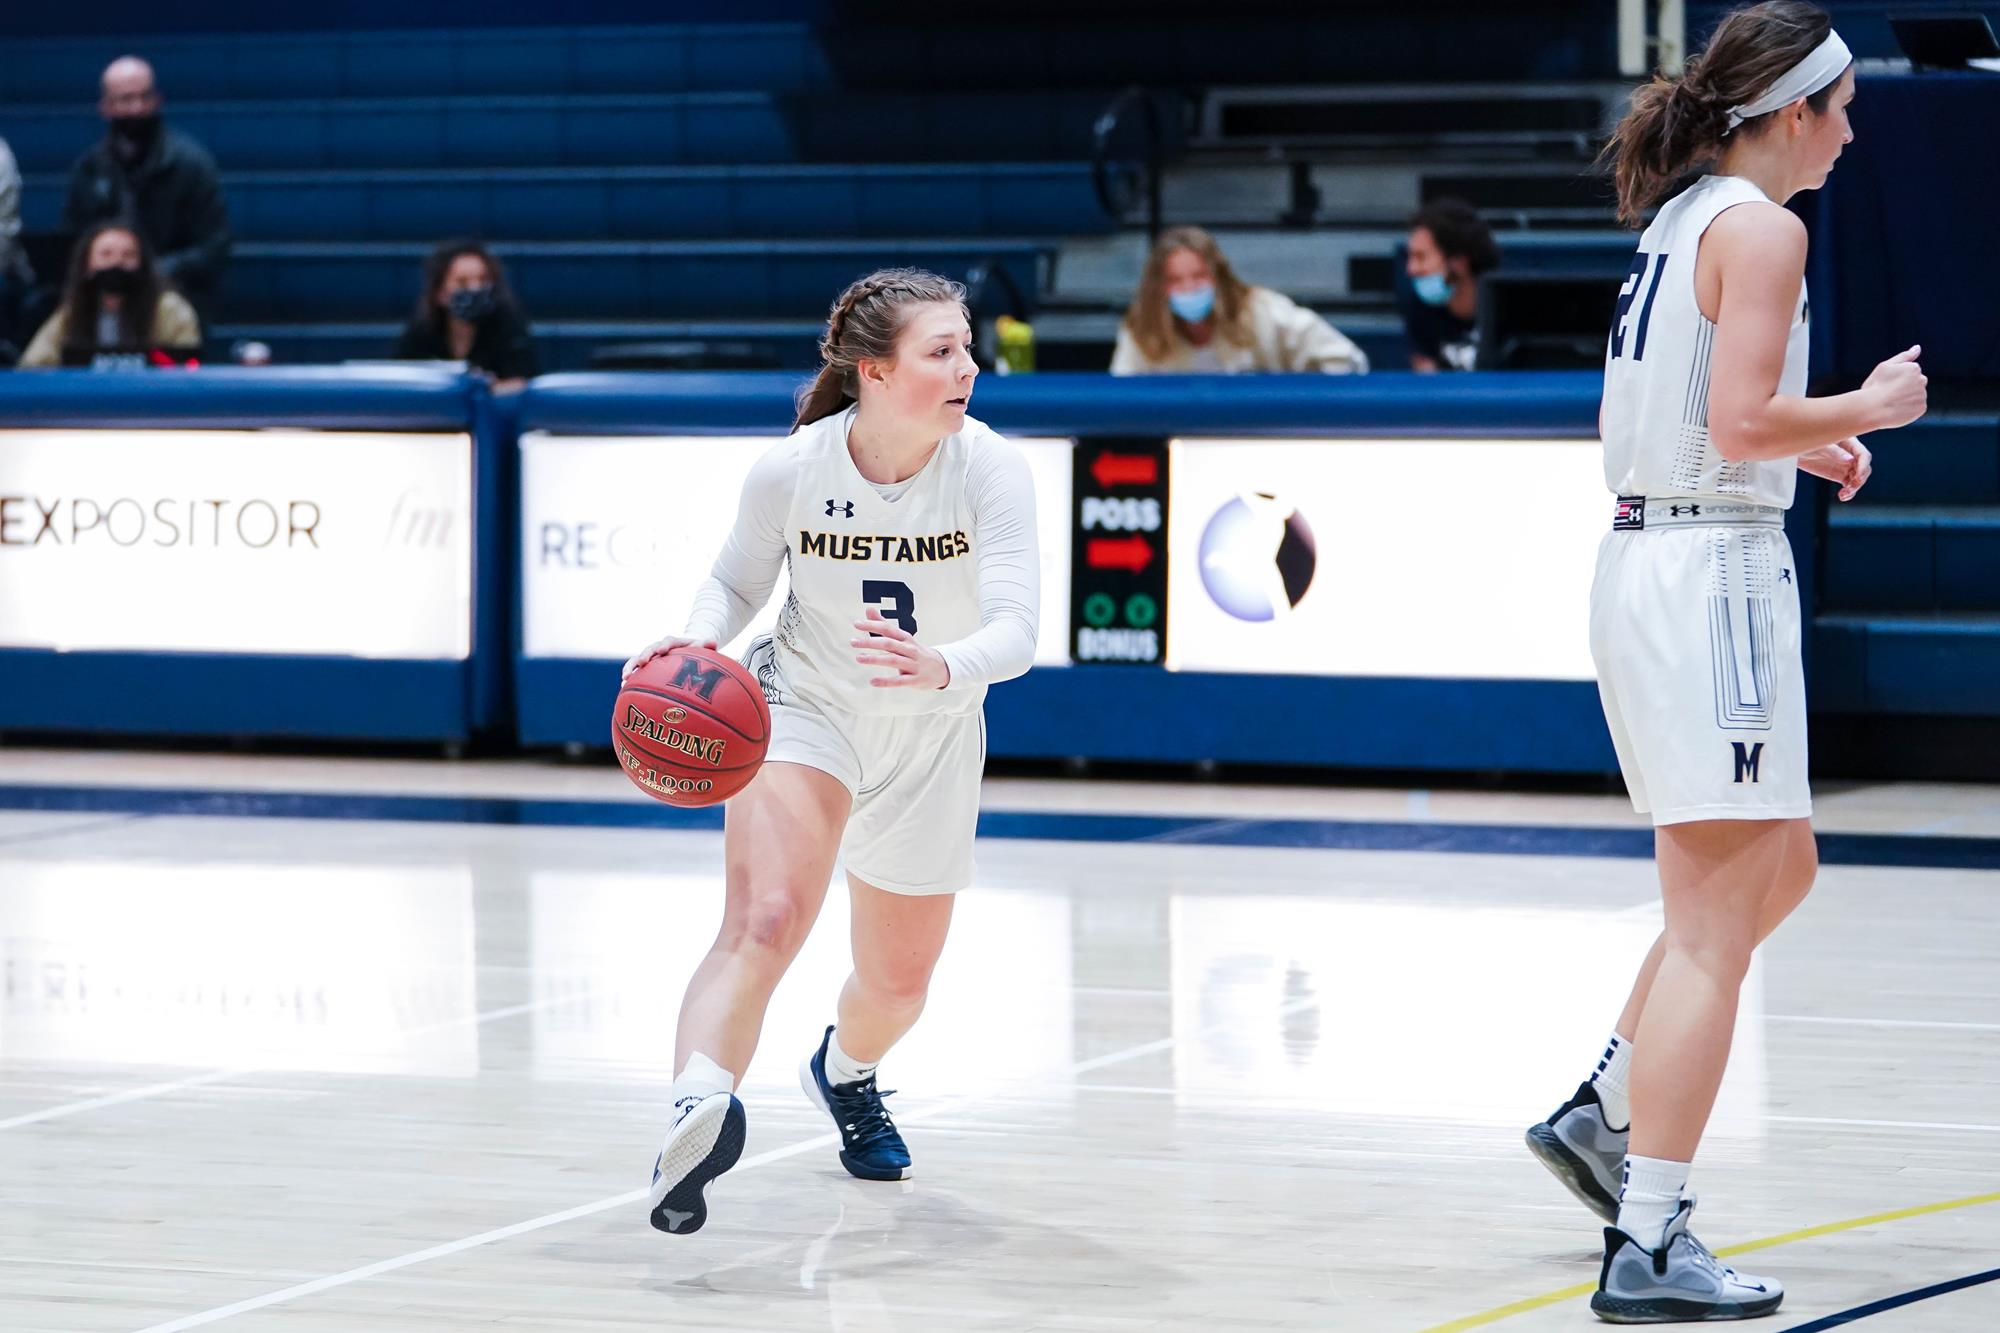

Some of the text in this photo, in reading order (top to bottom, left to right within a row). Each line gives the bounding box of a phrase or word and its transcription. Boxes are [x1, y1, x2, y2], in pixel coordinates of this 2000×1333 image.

[1612, 252, 1669, 361] 21
[0, 497, 322, 549] EXPOSITOR
[1081, 496, 1161, 532] POSS
[799, 529, 970, 563] MUSTANGS
[862, 579, 917, 638] 3
[666, 656, 729, 703] M
[624, 704, 725, 766] SPALDING
[1730, 741, 1765, 783] M
